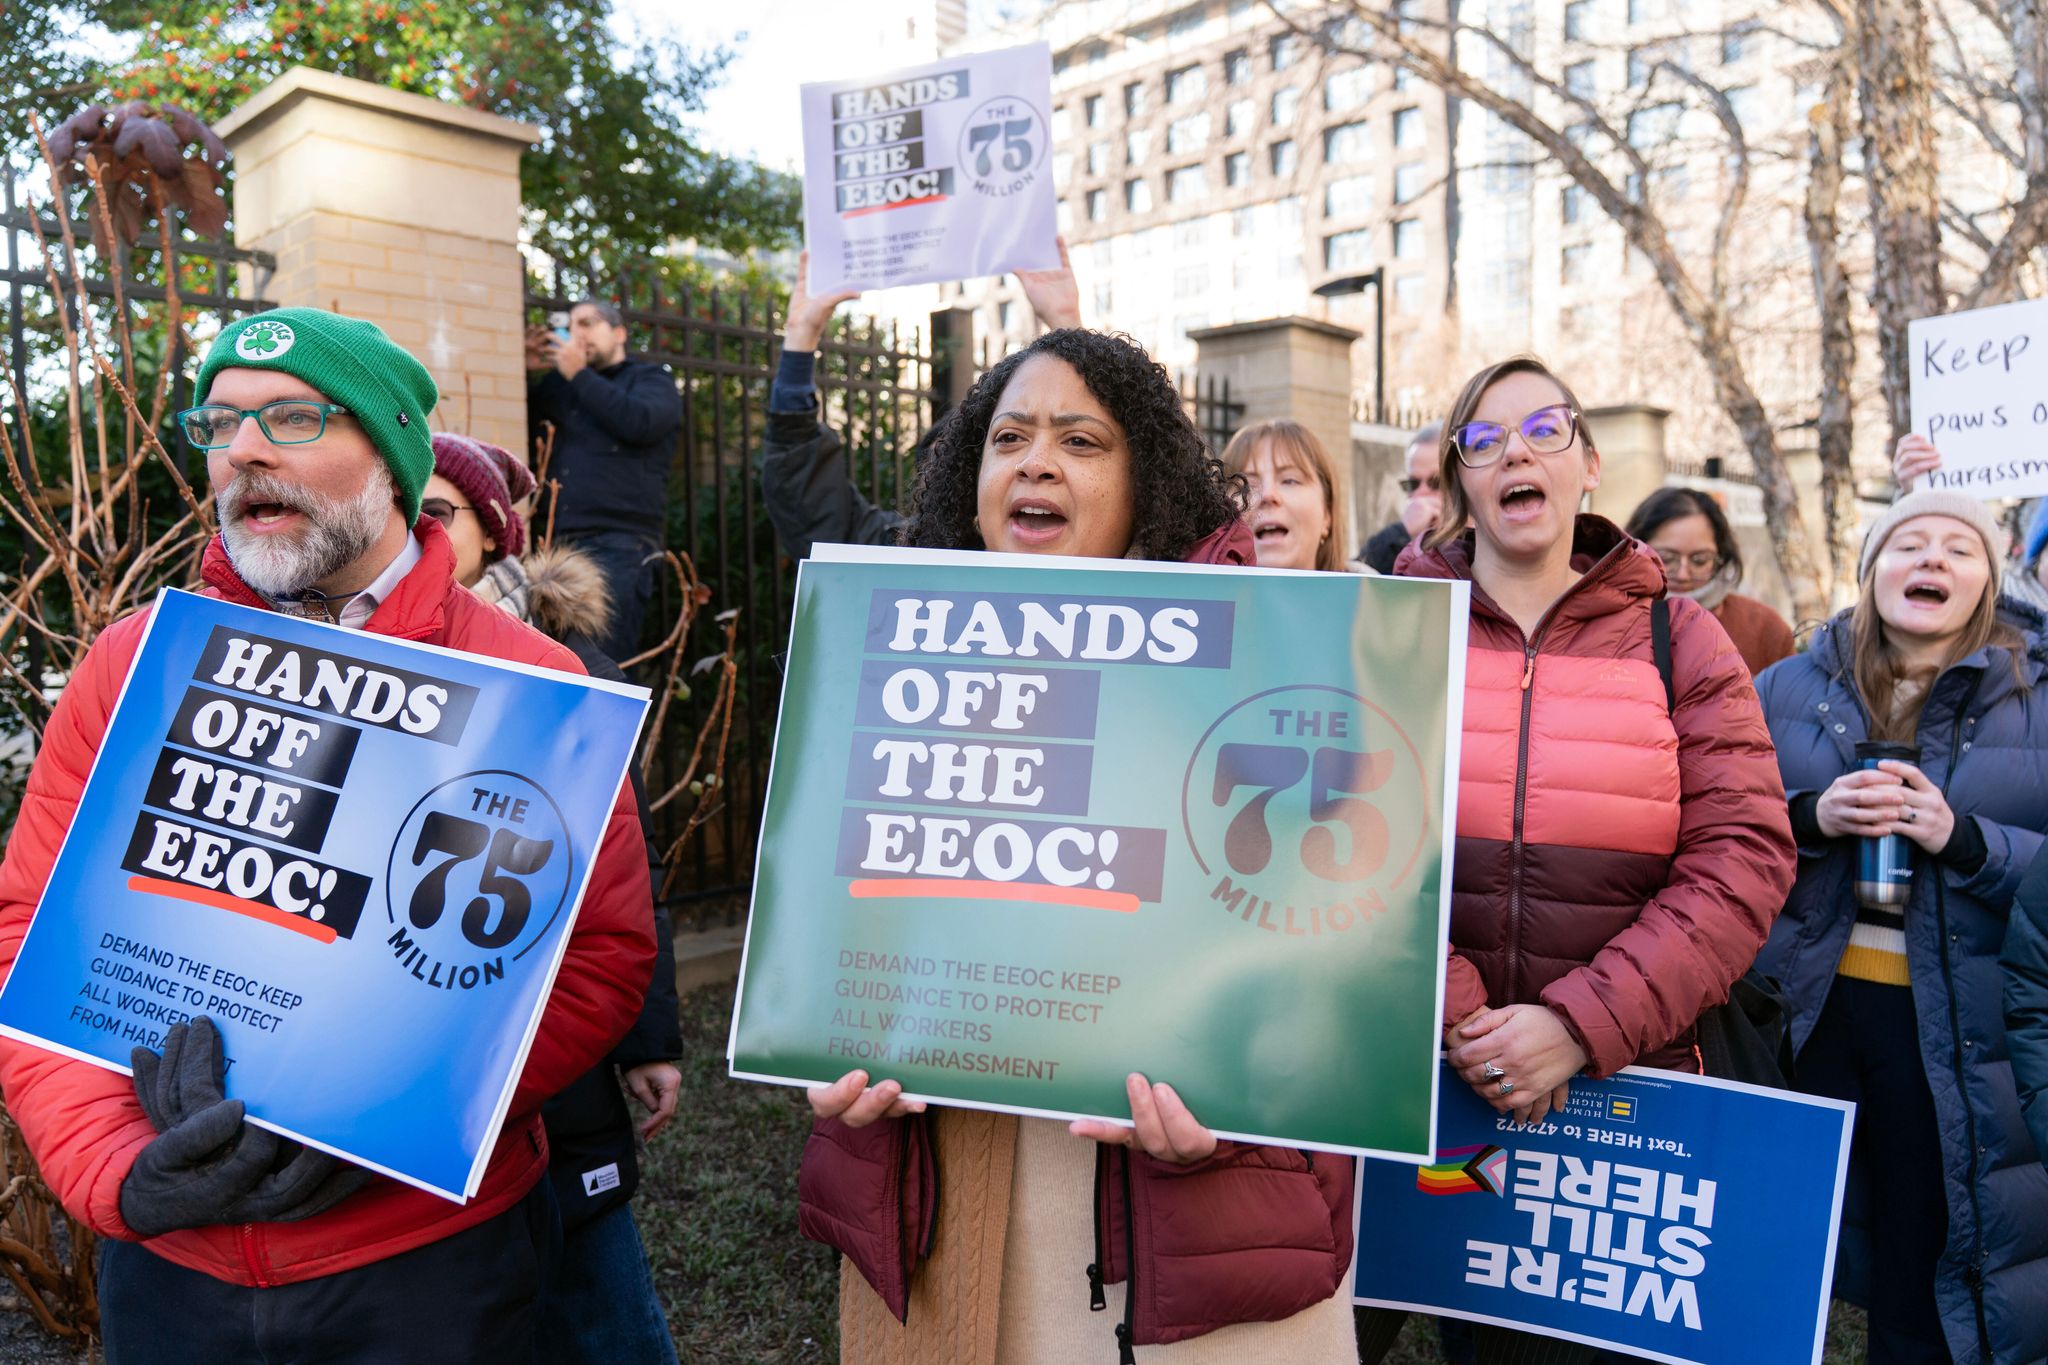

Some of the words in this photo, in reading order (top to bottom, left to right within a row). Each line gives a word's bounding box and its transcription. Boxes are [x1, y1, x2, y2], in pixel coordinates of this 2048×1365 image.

[840, 75, 959, 118] HANDS
[986, 105, 1016, 118] THE
[841, 115, 906, 147] OFF
[969, 116, 1034, 178] 75
[842, 145, 910, 178] THE
[844, 171, 940, 210] EEOC!
[973, 173, 1036, 198] MILLION
[243, 322, 292, 340] CELTICS
[1925, 334, 2030, 378] Keep
[1928, 404, 2008, 446] paws
[888, 597, 1201, 664] HANDS
[212, 637, 449, 735] HANDS
[881, 668, 1049, 730] OFF
[191, 699, 320, 769] OFF
[1268, 708, 1349, 739] THE
[872, 738, 1044, 808] THE
[170, 757, 303, 840] THE
[470, 787, 531, 824] THE
[1211, 742, 1395, 885] 75
[141, 819, 339, 921] EEOC!
[860, 812, 1121, 891] EEOC!
[407, 810, 555, 950] 75
[1210, 875, 1390, 937] MILLION
[100, 932, 174, 968] DEMAND
[177, 956, 212, 981] THE
[212, 968, 258, 997] EEOC
[258, 984, 303, 1011] KEEP
[386, 925, 506, 991] MILLION
[838, 949, 936, 978] DEMAND
[942, 959, 987, 983] THE
[992, 965, 1055, 989] EEOC
[1060, 971, 1121, 996] KEEP
[79, 981, 111, 1005] ALL
[117, 991, 195, 1028] WORKER
[91, 957, 180, 999] GUIDANCE
[183, 985, 204, 1006] TO
[206, 995, 283, 1033] PROTECT
[834, 978, 953, 1009] GUIDANCE
[957, 990, 989, 1012] TO
[995, 994, 1104, 1025] PROTECT
[70, 1005, 121, 1035] FROM
[830, 1007, 873, 1030] ALL
[877, 1011, 993, 1044] WORKERS
[828, 1036, 892, 1062] FROM
[898, 1045, 1060, 1082] HARASSMENT
[1563, 1124, 1582, 1139] to
[1564, 1106, 1602, 1118] HUMA
[1587, 1128, 1643, 1150] HERE
[1514, 1149, 1718, 1229] HERE
[1514, 1198, 1712, 1277] STILL
[1465, 1240, 1703, 1331] WE'RE
